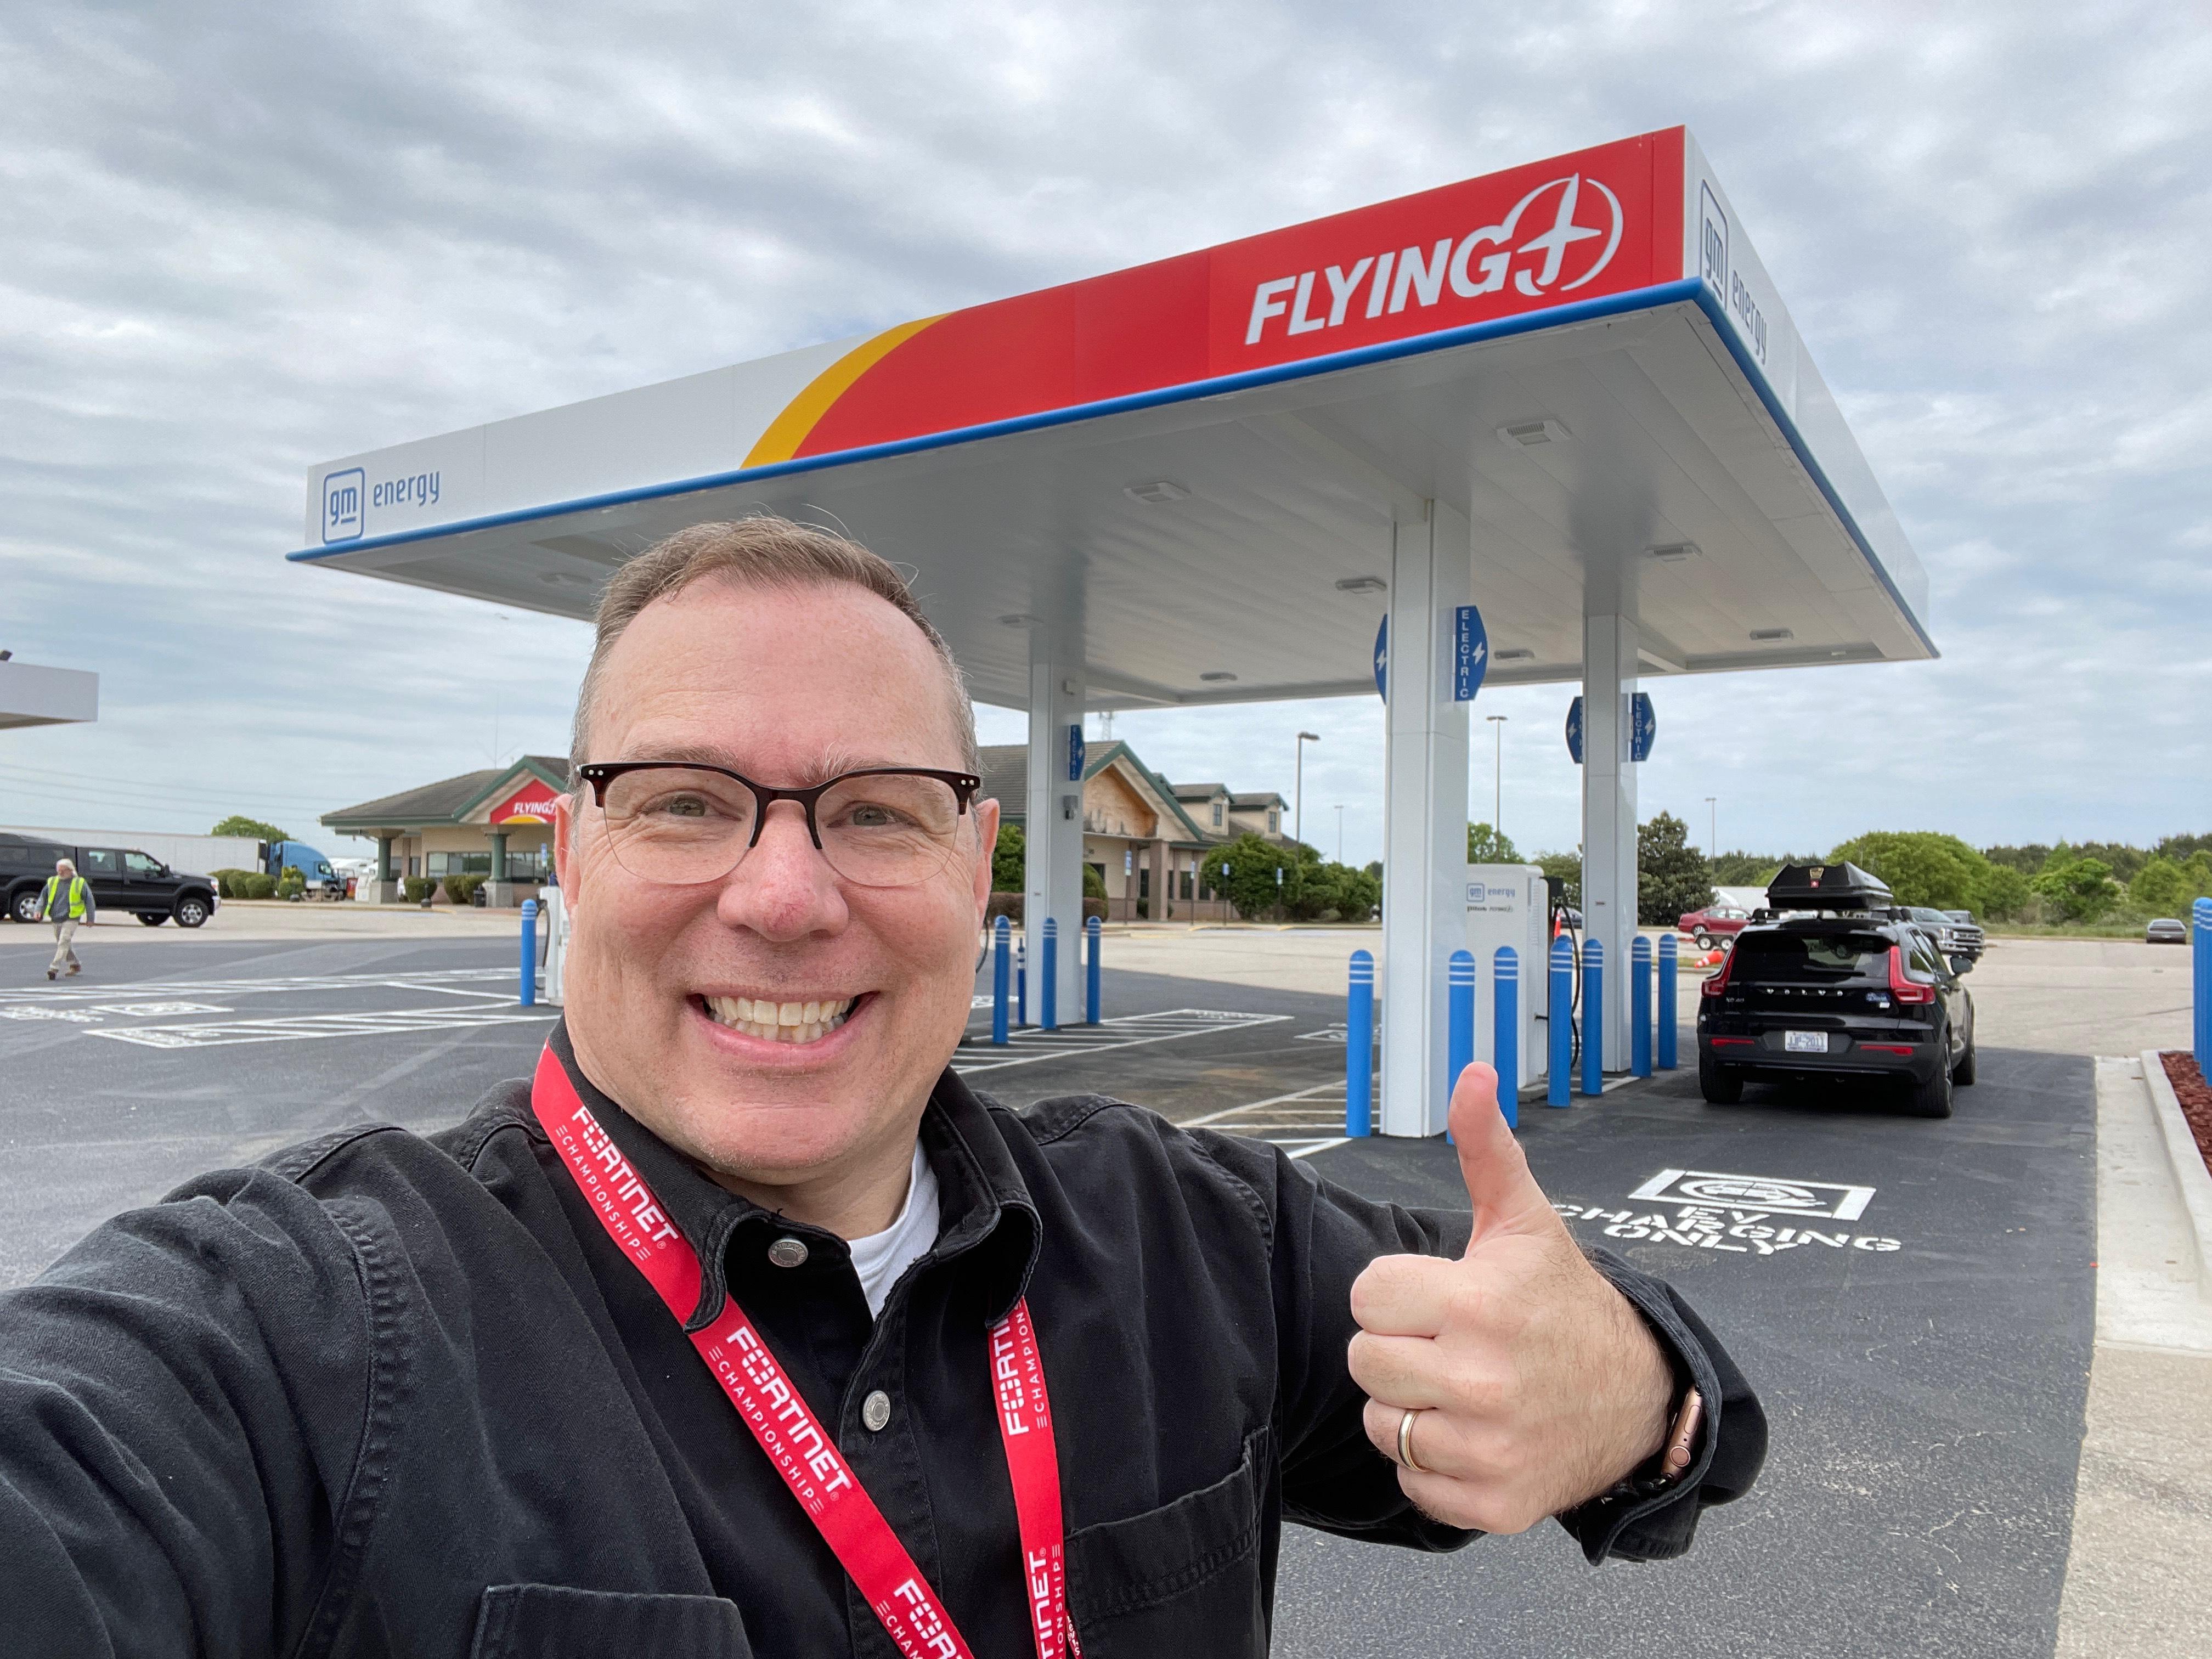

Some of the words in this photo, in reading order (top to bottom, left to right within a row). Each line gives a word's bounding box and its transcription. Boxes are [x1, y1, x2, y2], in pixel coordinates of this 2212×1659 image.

[1244, 223, 1511, 346] FLYING
[1705, 217, 1724, 284] gm
[1732, 269, 1767, 366] energy
[330, 487, 357, 526] gm
[373, 471, 441, 508] energy
[1459, 609, 1470, 698] ELECTRIC
[1634, 695, 1643, 760] ELECTRIC
[514, 802, 549, 814] FLYING
[1487, 888, 1516, 898] energy
[1766, 987, 1843, 997] VOLVO
[561, 1135, 640, 1248] CHAMPIONSHIP
[572, 1105, 679, 1244] FORTINET
[1677, 1205, 1770, 1224] EV
[1603, 1223, 1798, 1255] ONLY
[718, 1360, 815, 1499] CHAMPIONSHIP
[726, 1326, 853, 1493] FORTINET
[893, 1578, 963, 1659] FOR
[1052, 1561, 1064, 1659] IONSHIP
